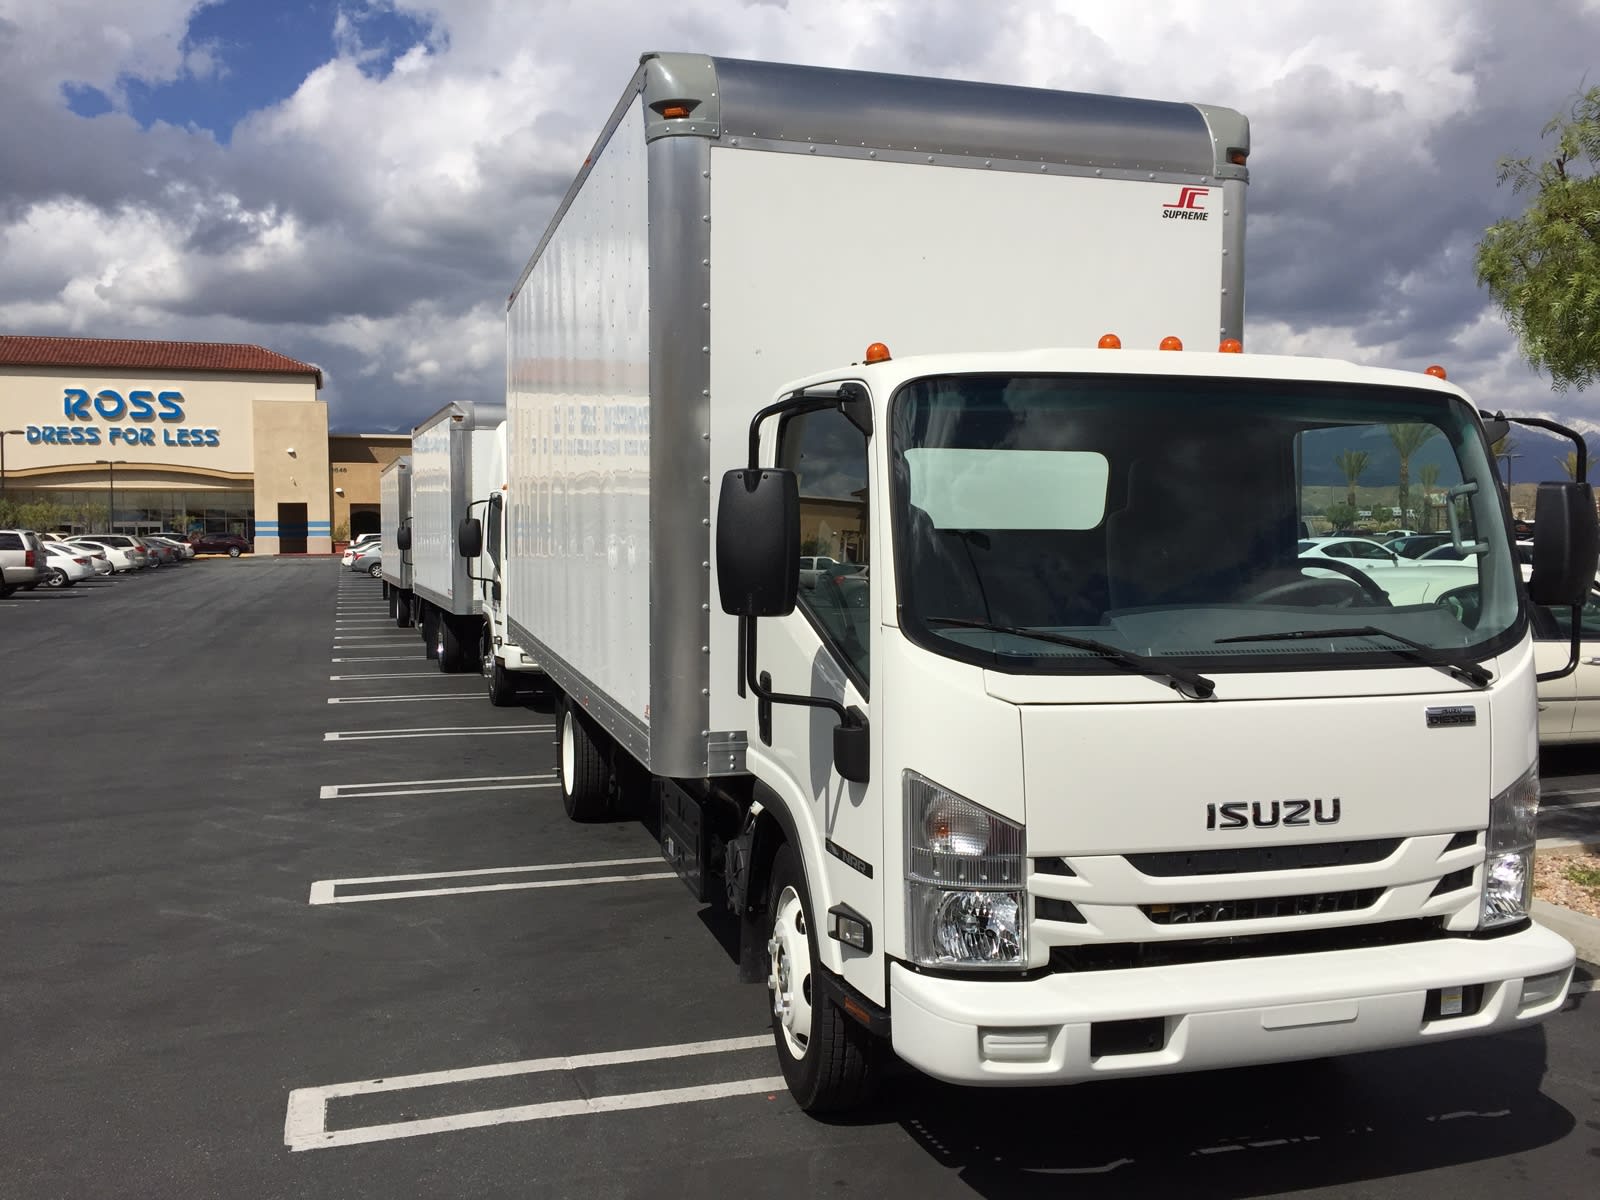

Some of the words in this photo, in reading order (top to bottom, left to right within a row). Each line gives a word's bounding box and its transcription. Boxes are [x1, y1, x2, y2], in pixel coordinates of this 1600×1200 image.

[1162, 209, 1208, 221] SUPREME
[63, 388, 186, 422] ROSS
[26, 426, 102, 445] DRESS
[108, 427, 156, 446] FOR
[163, 428, 220, 447] LESS
[1206, 797, 1341, 831] ISUZU
[842, 850, 866, 873] NRR
